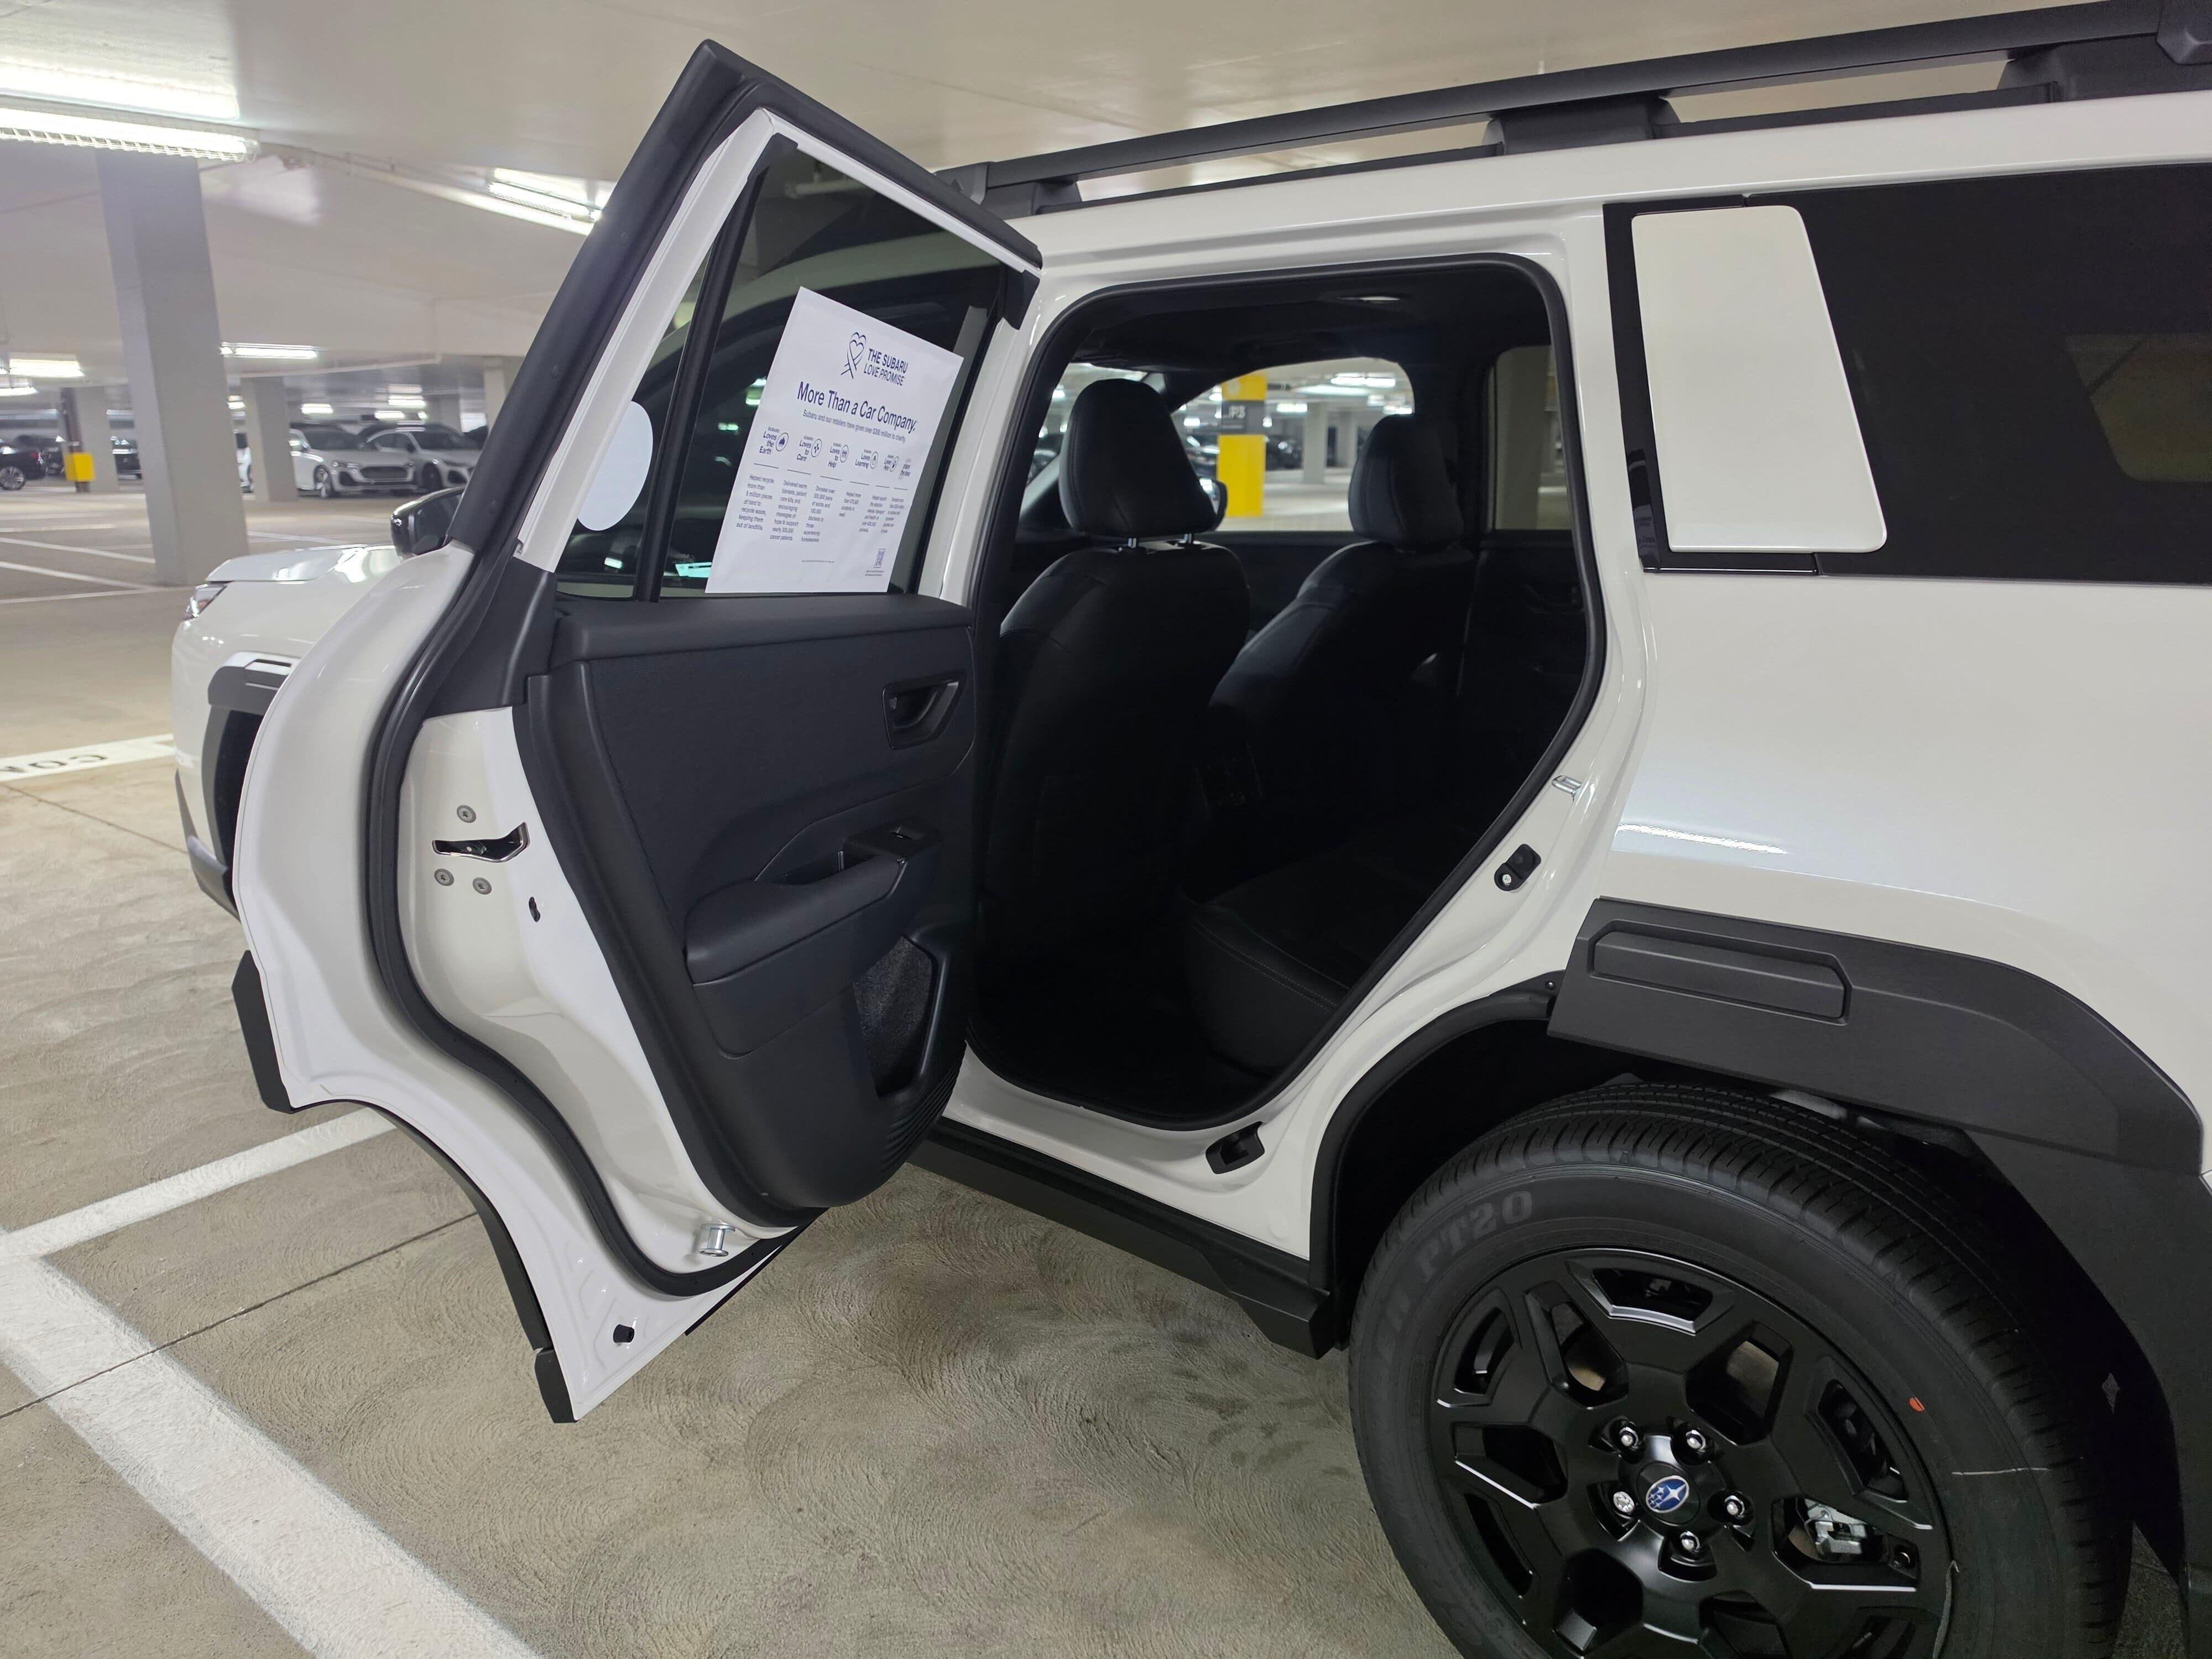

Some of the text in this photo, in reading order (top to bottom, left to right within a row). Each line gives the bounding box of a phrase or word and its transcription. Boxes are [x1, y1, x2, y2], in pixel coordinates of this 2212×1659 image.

[868, 348, 909, 374] THE SUBARU
[863, 363, 905, 386] LOVE PROMISE
[797, 381, 916, 434] More Than a Car Company.
[803, 409, 817, 421] Subaru
[763, 431, 778, 441] Loves
[799, 440, 812, 448] Loves
[759, 446, 771, 455] Earth
[796, 453, 807, 462] Care
[828, 461, 836, 469] Help
[1415, 1190, 1533, 1284] PT20
